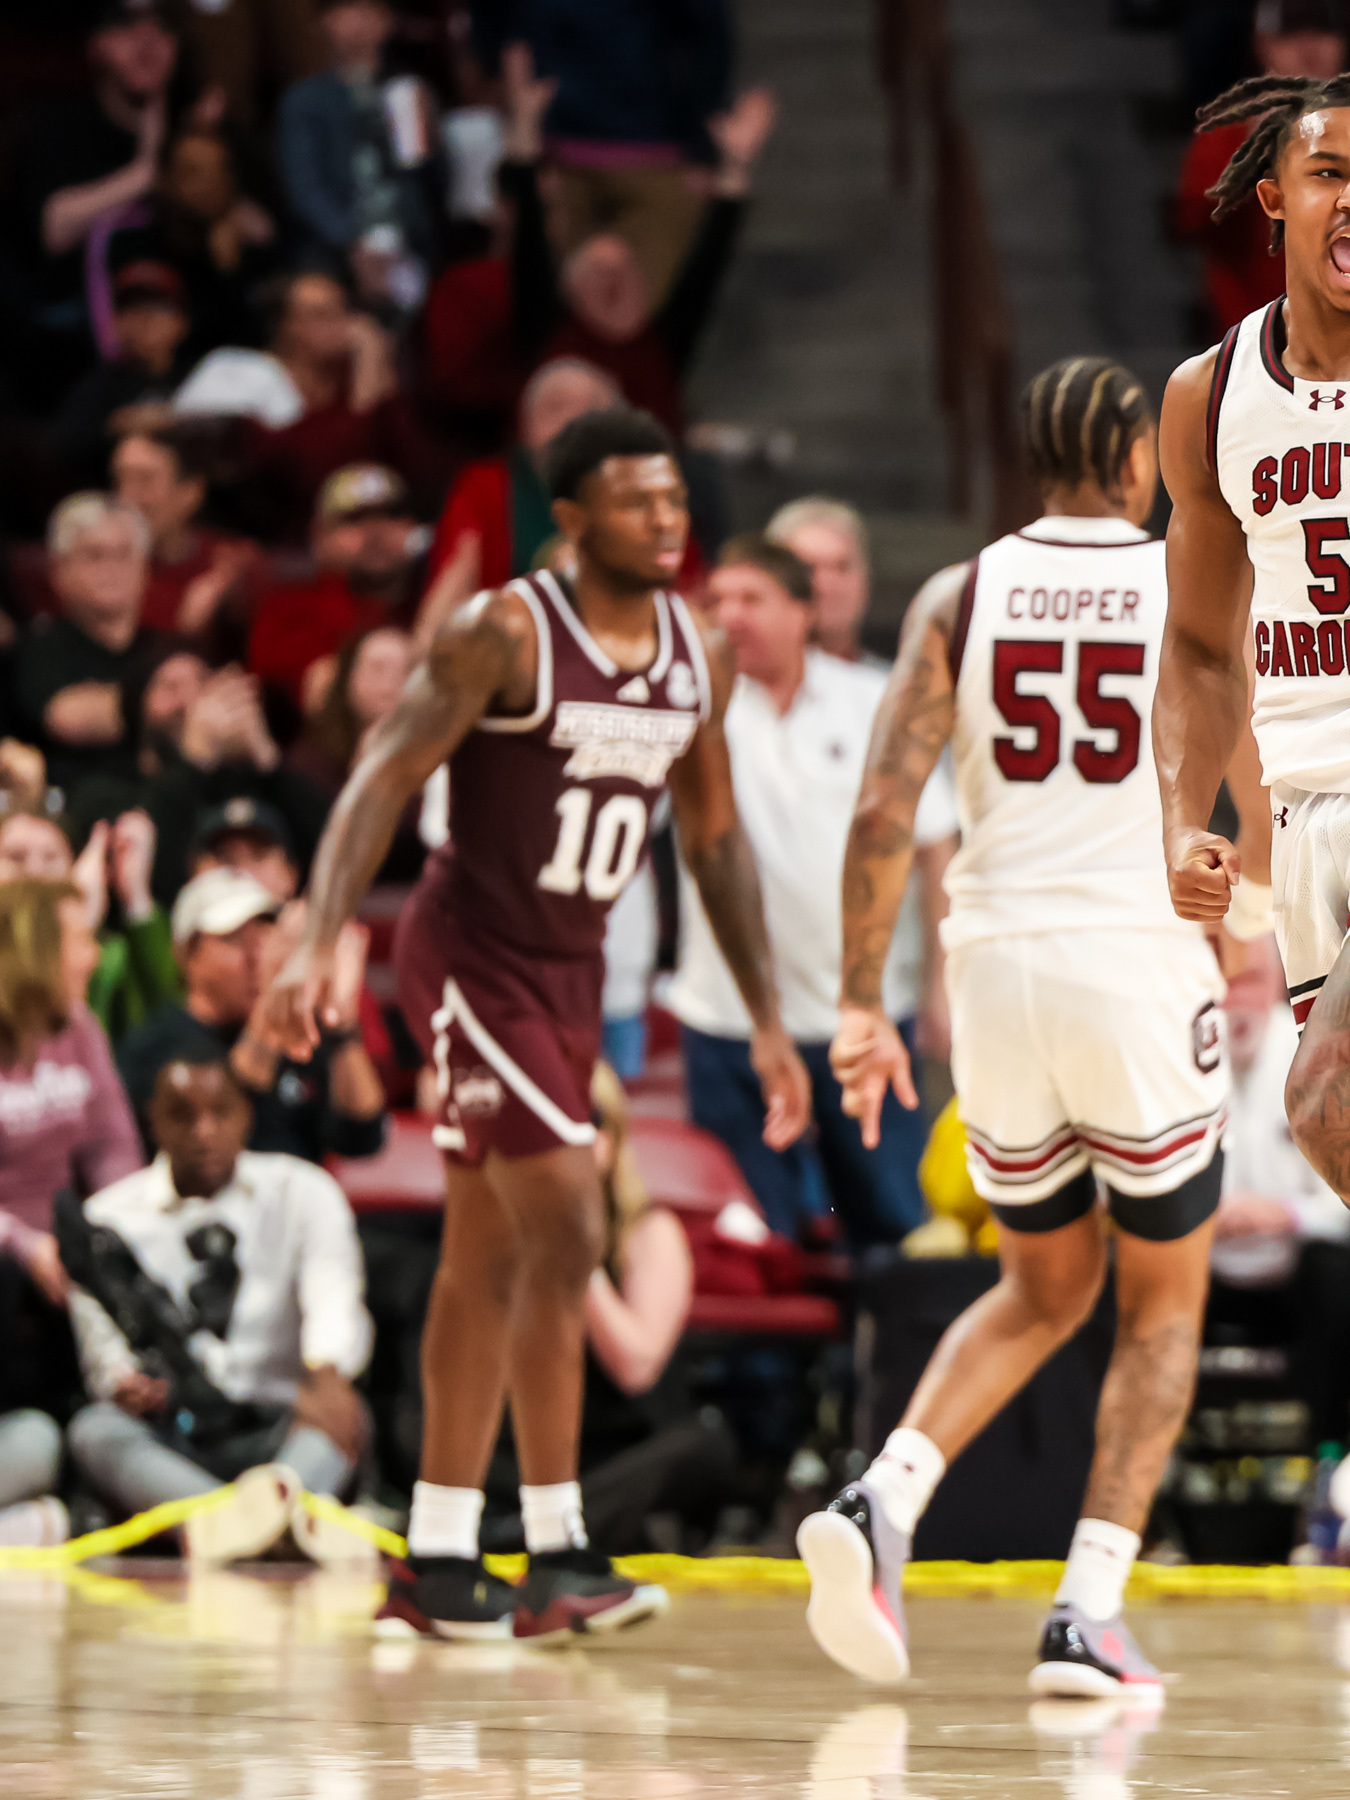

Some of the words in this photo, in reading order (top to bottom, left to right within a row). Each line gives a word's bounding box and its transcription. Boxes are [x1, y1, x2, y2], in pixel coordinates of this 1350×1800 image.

[1007, 587, 1140, 622] COOPER
[992, 640, 1146, 784] 55
[540, 786, 647, 900] 10
